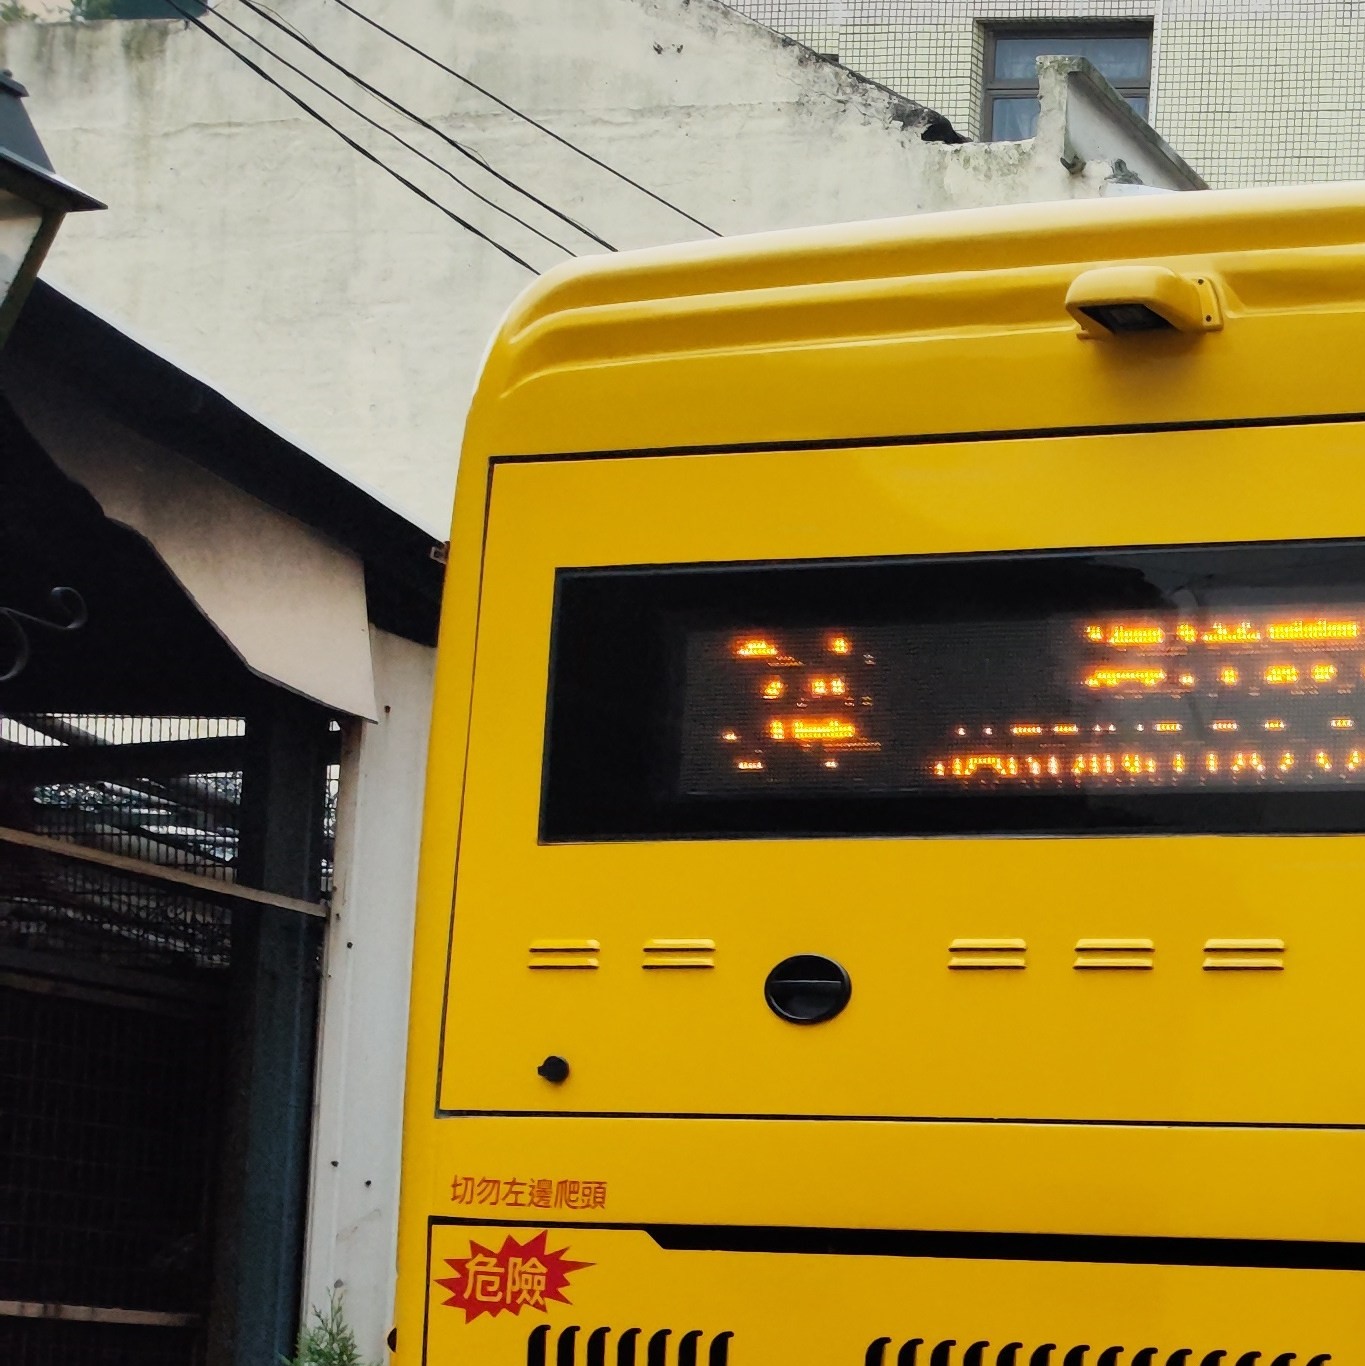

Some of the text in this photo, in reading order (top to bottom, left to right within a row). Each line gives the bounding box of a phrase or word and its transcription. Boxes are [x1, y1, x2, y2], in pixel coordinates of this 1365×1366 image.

[450, 1175, 607, 1210] 切勿左邊爬頭
[463, 1253, 548, 1306] 危險
